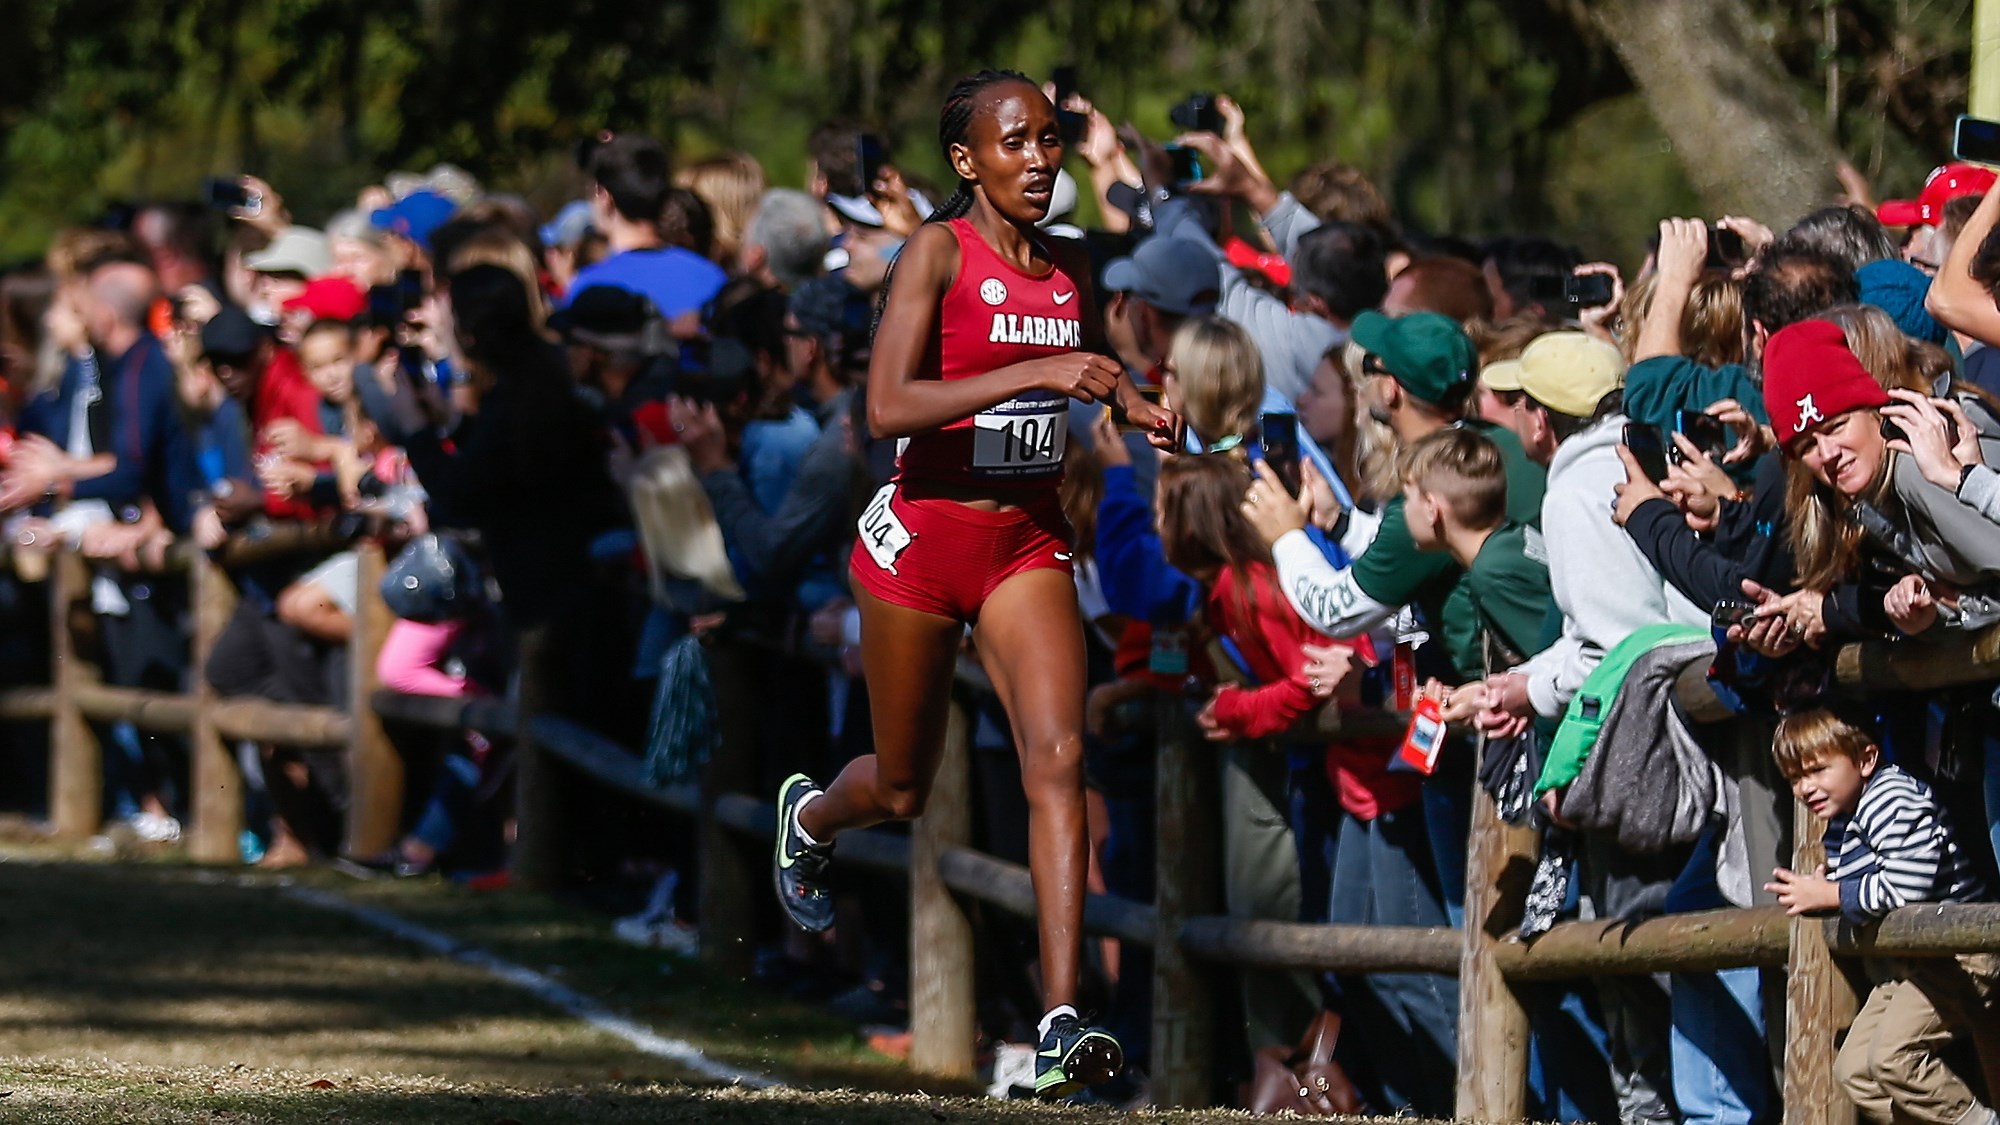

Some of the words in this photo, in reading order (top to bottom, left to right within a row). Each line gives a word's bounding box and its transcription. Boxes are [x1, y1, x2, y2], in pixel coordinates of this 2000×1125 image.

[981, 279, 1006, 304] SEC
[1793, 392, 1824, 433] A
[1001, 416, 1057, 463] 104
